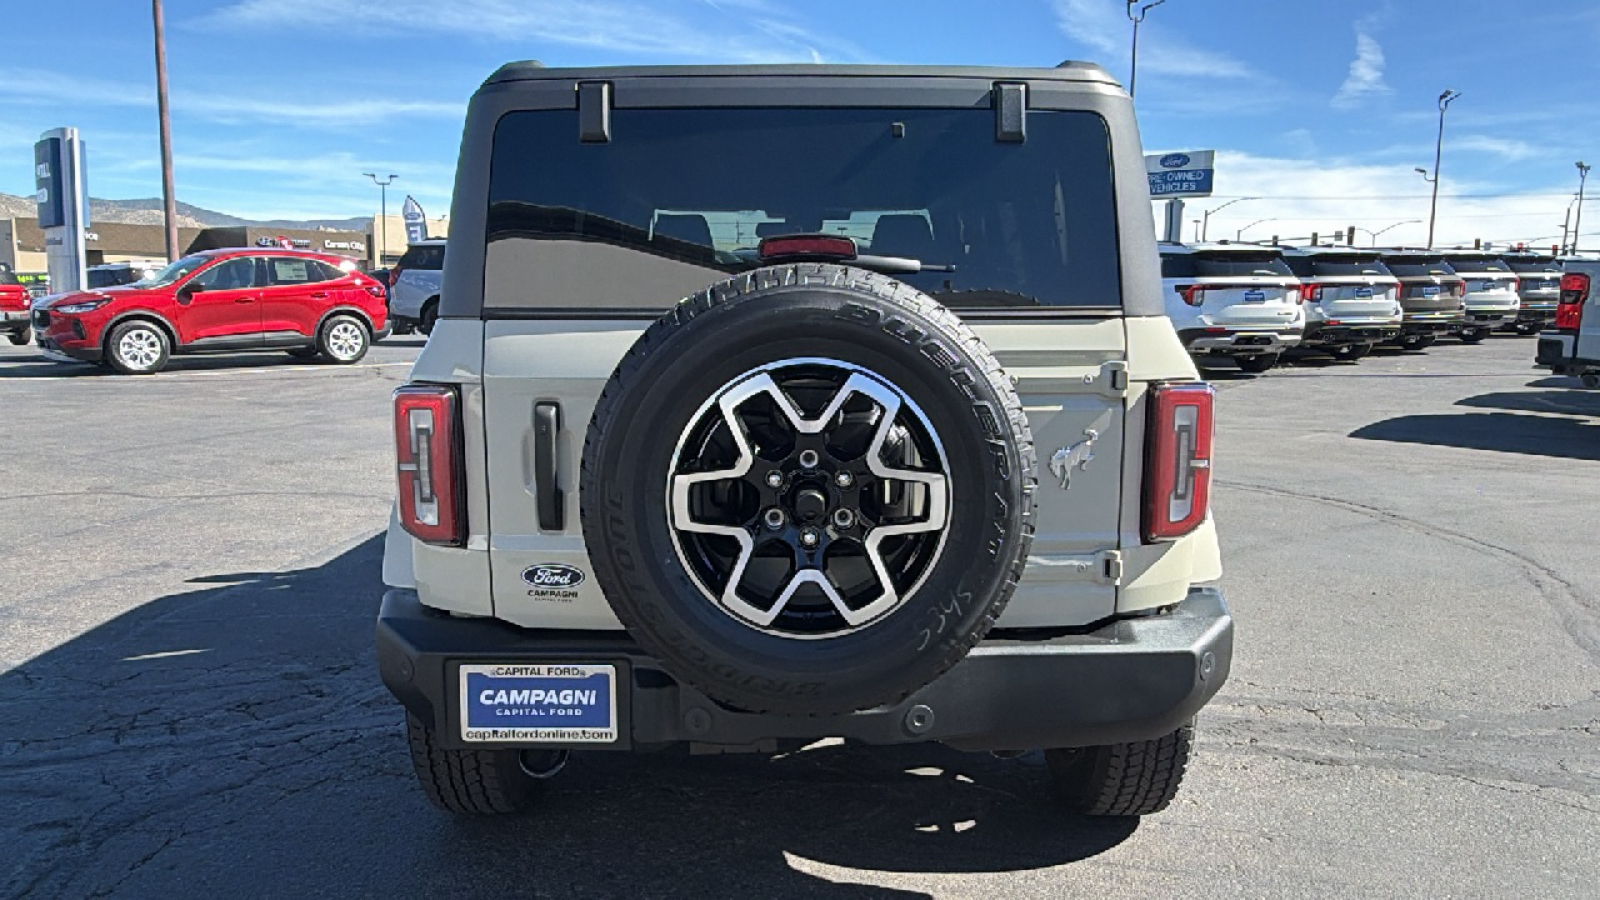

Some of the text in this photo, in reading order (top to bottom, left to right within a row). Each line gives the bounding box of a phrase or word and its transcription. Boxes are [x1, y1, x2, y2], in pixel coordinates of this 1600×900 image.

[1151, 182, 1197, 193] VEHICLES
[533, 568, 573, 584] Ford
[527, 589, 578, 598] CAMPAGNI
[495, 667, 580, 677] CAPITAL FORD
[479, 689, 597, 705] CAMPAGNI
[495, 708, 583, 716] CAPITAL FORD
[466, 729, 614, 741] capitalfordonline.com
